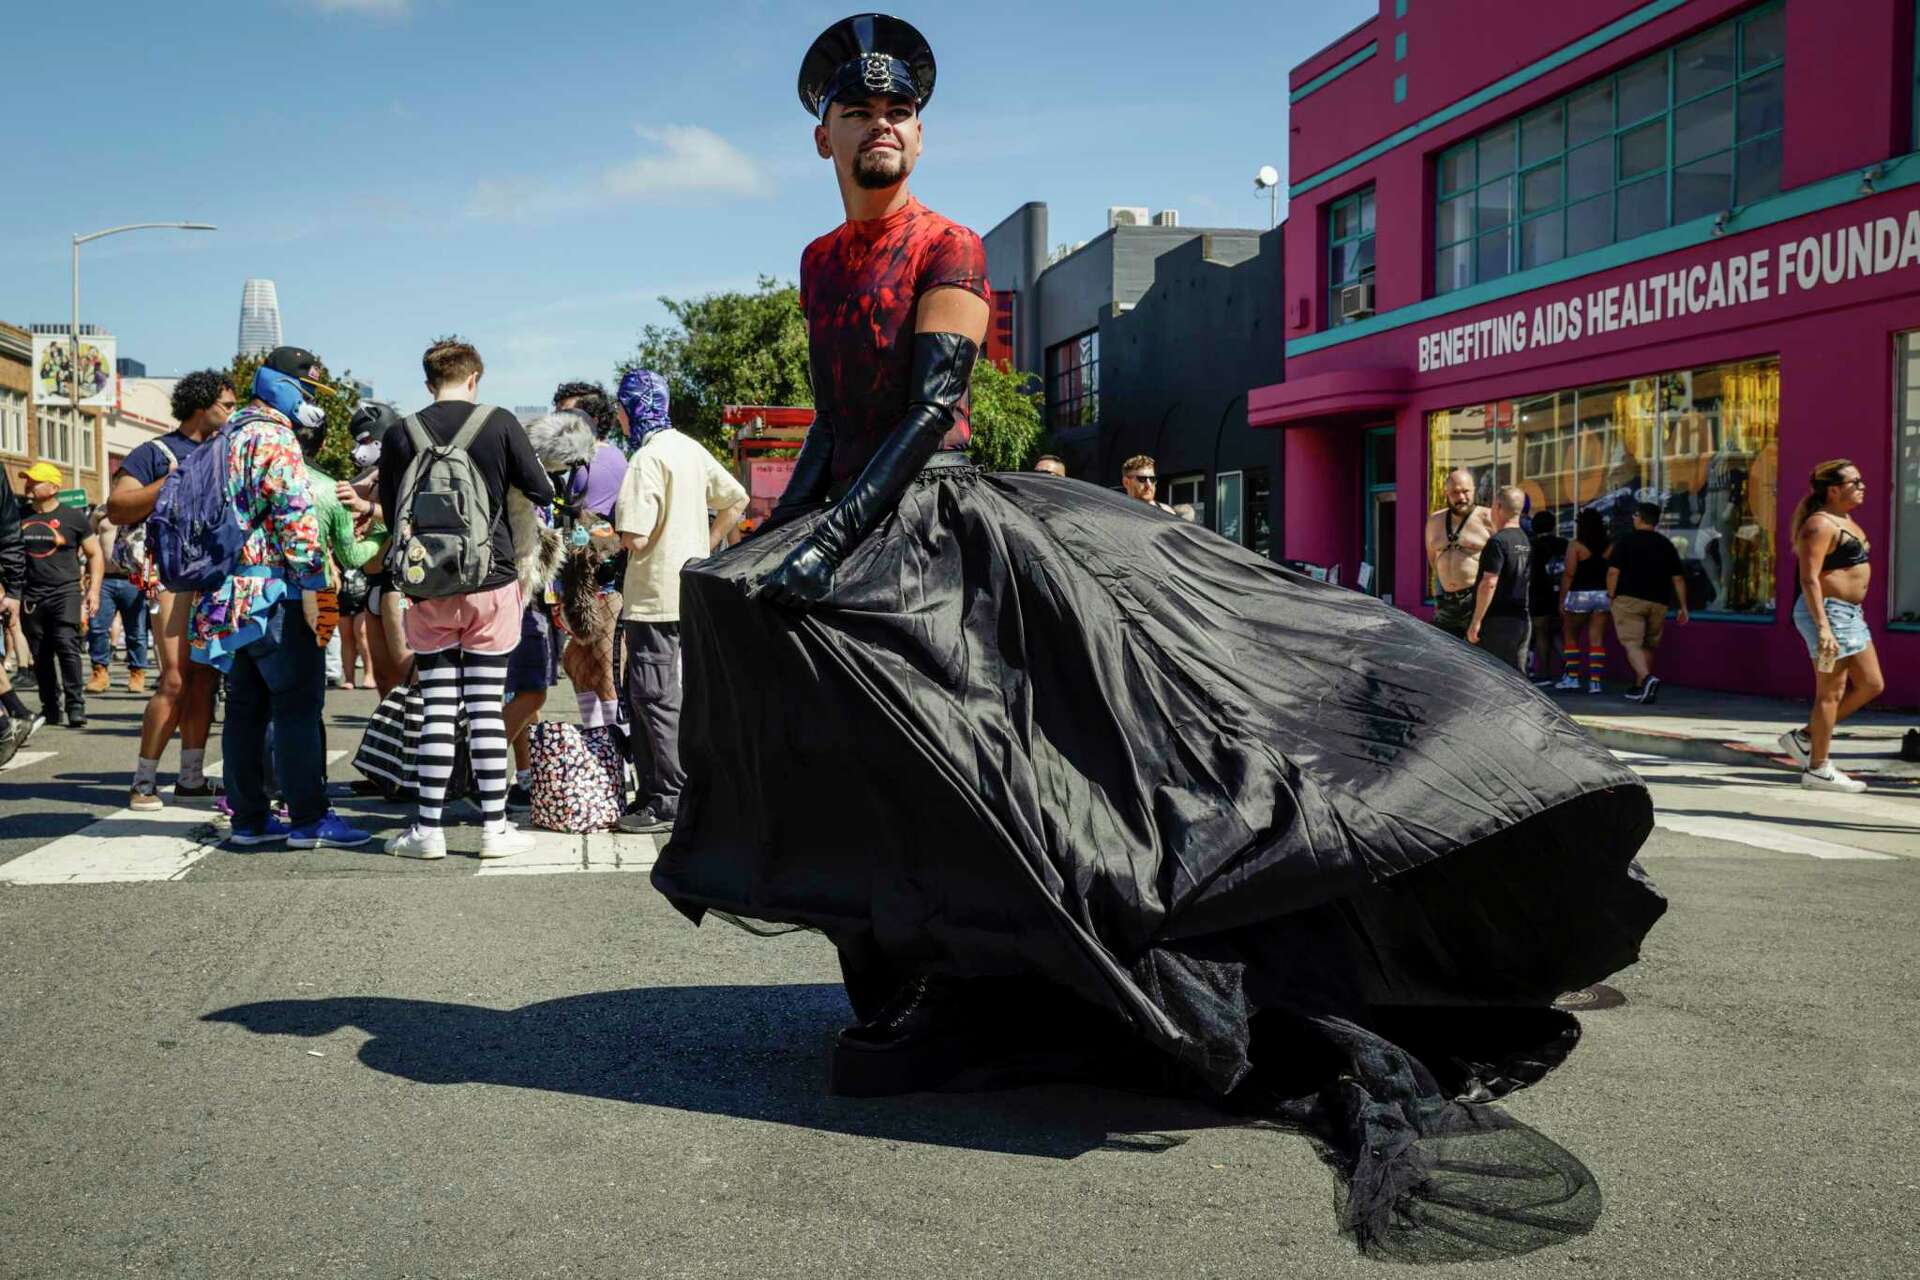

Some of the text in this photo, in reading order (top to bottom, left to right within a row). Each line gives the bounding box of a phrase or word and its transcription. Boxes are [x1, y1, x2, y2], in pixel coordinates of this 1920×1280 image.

[1418, 210, 1920, 372] BENEFITING AIDS HEALTHCARE FOUNDA
